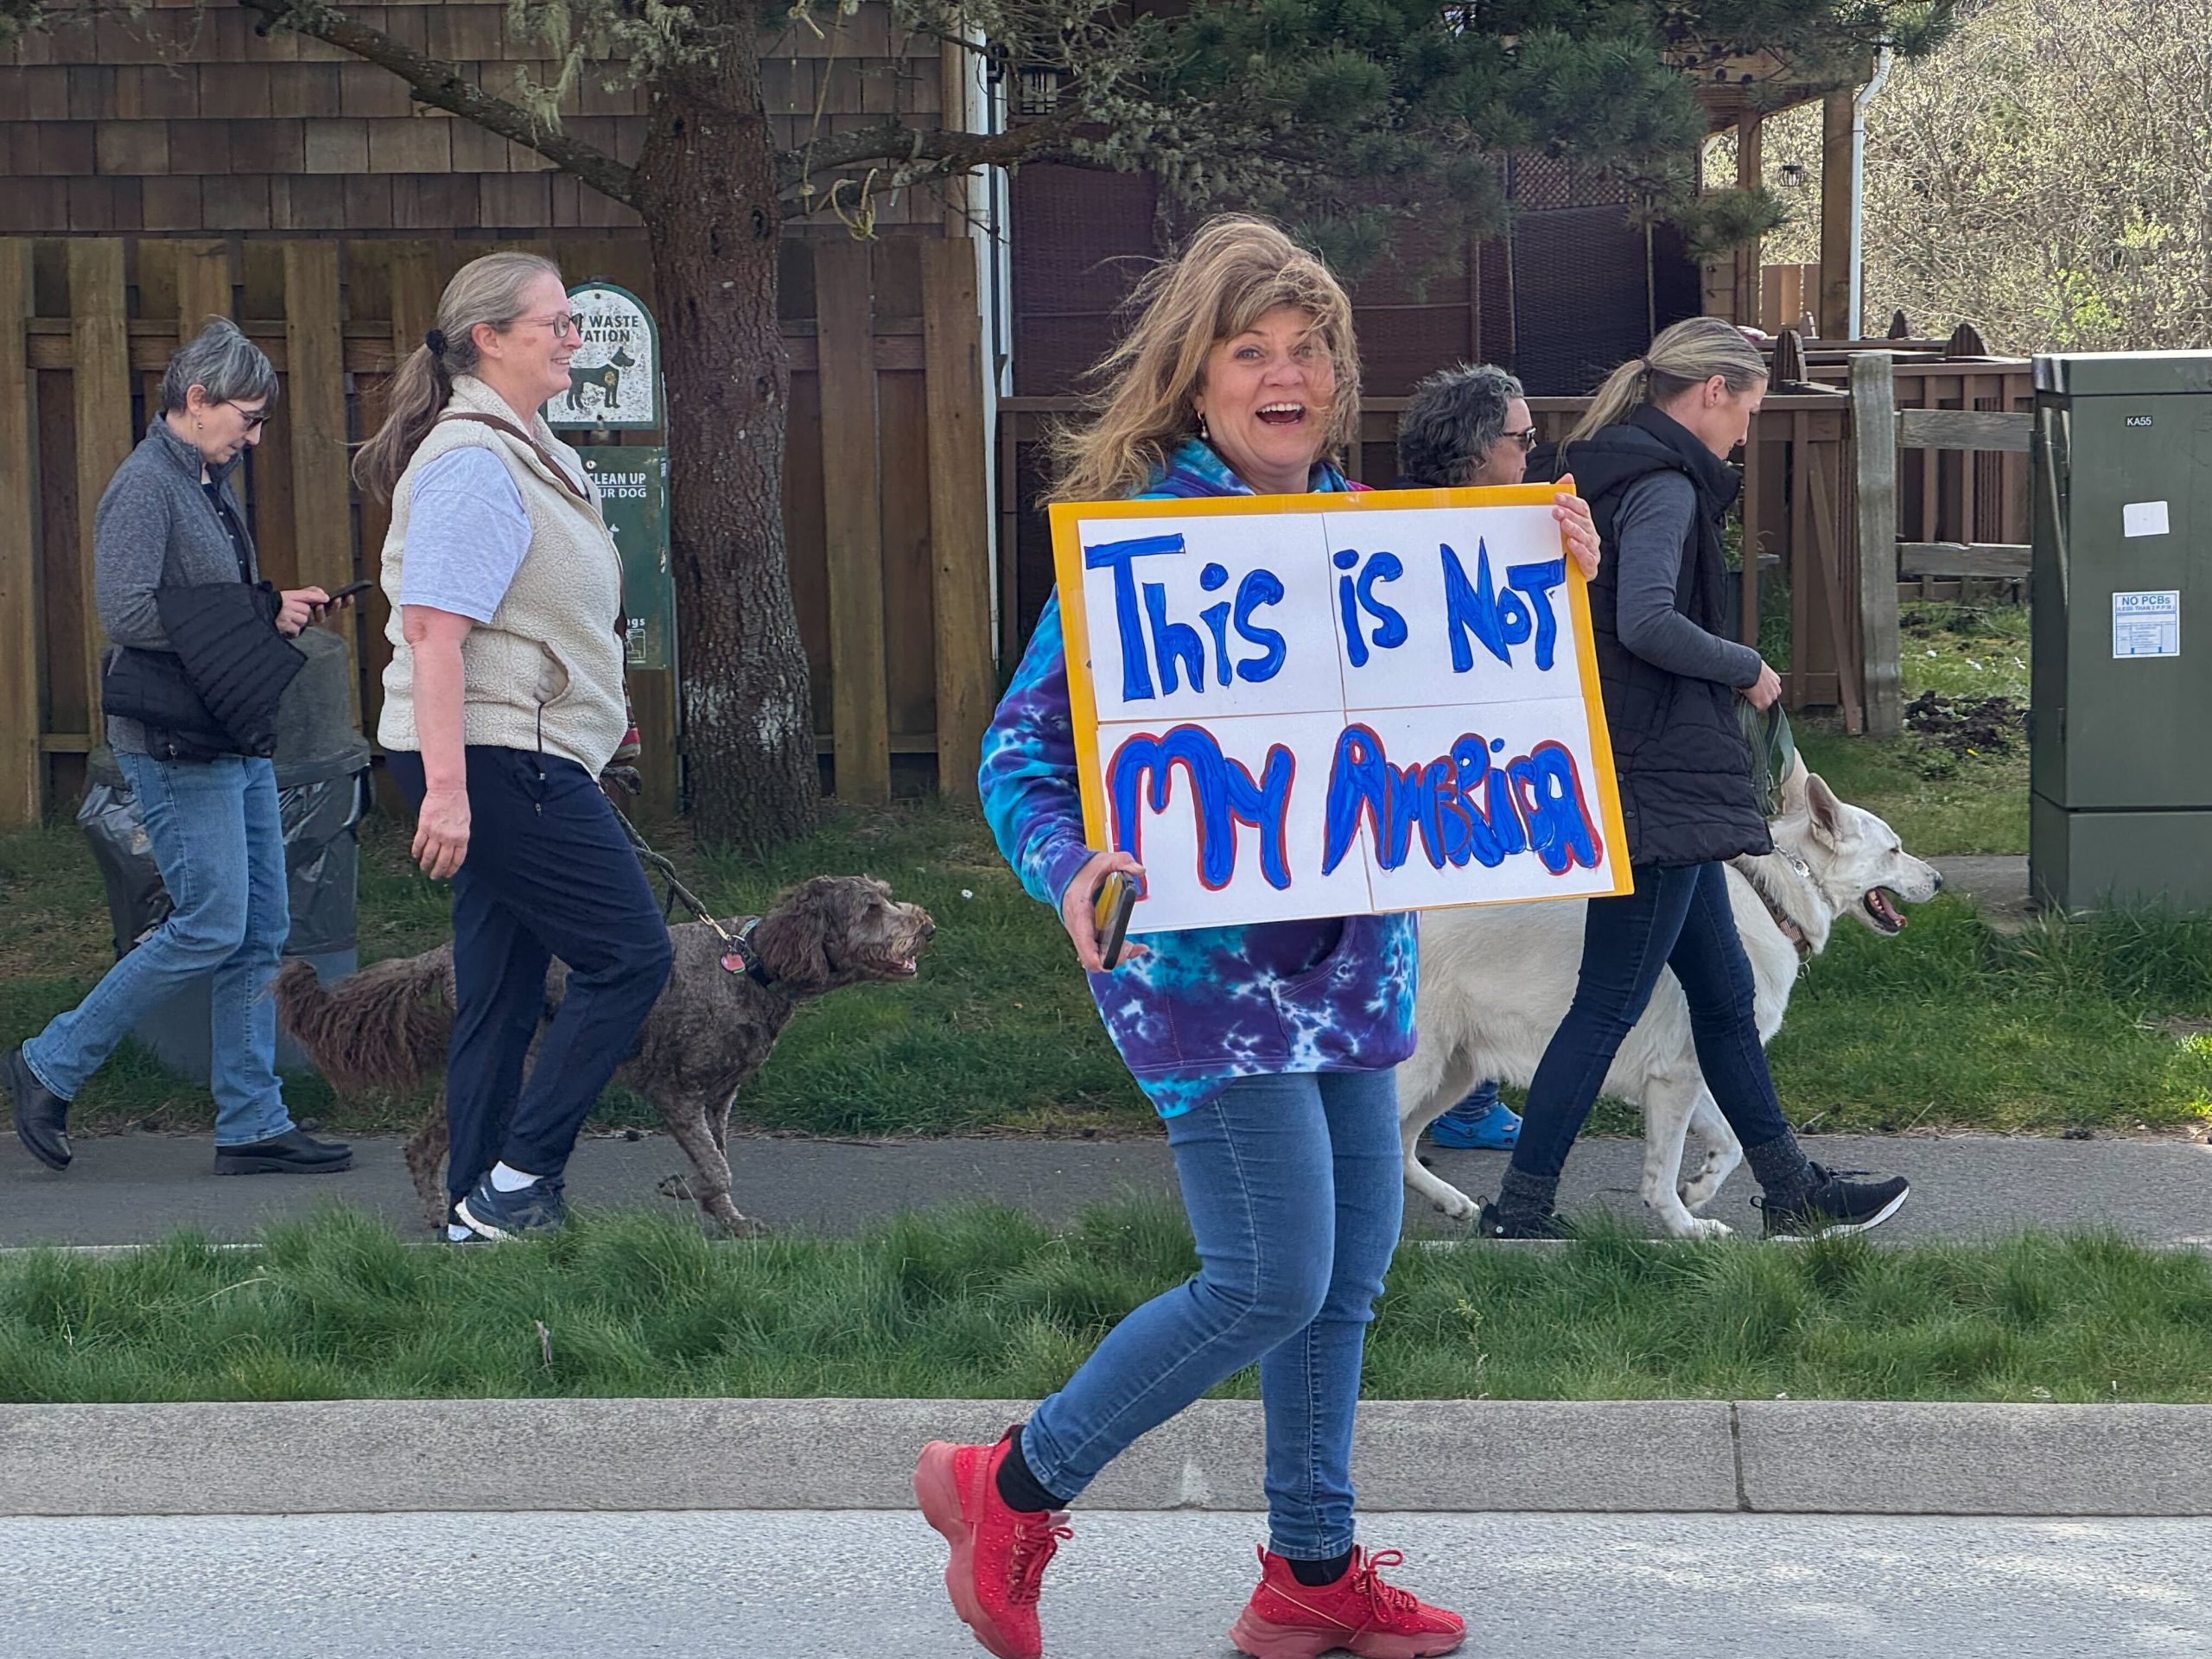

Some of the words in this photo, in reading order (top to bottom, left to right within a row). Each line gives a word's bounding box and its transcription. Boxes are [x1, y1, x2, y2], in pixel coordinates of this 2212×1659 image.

[588, 315, 639, 327] WASTE
[2126, 416, 2152, 426] KA55
[629, 473, 646, 485] UP
[599, 488, 615, 499] UR
[619, 487, 647, 499] DOG
[2122, 596, 2139, 606] NO
[2141, 595, 2171, 605] PCBs
[1084, 533, 1286, 702] This
[1332, 548, 1408, 668] is
